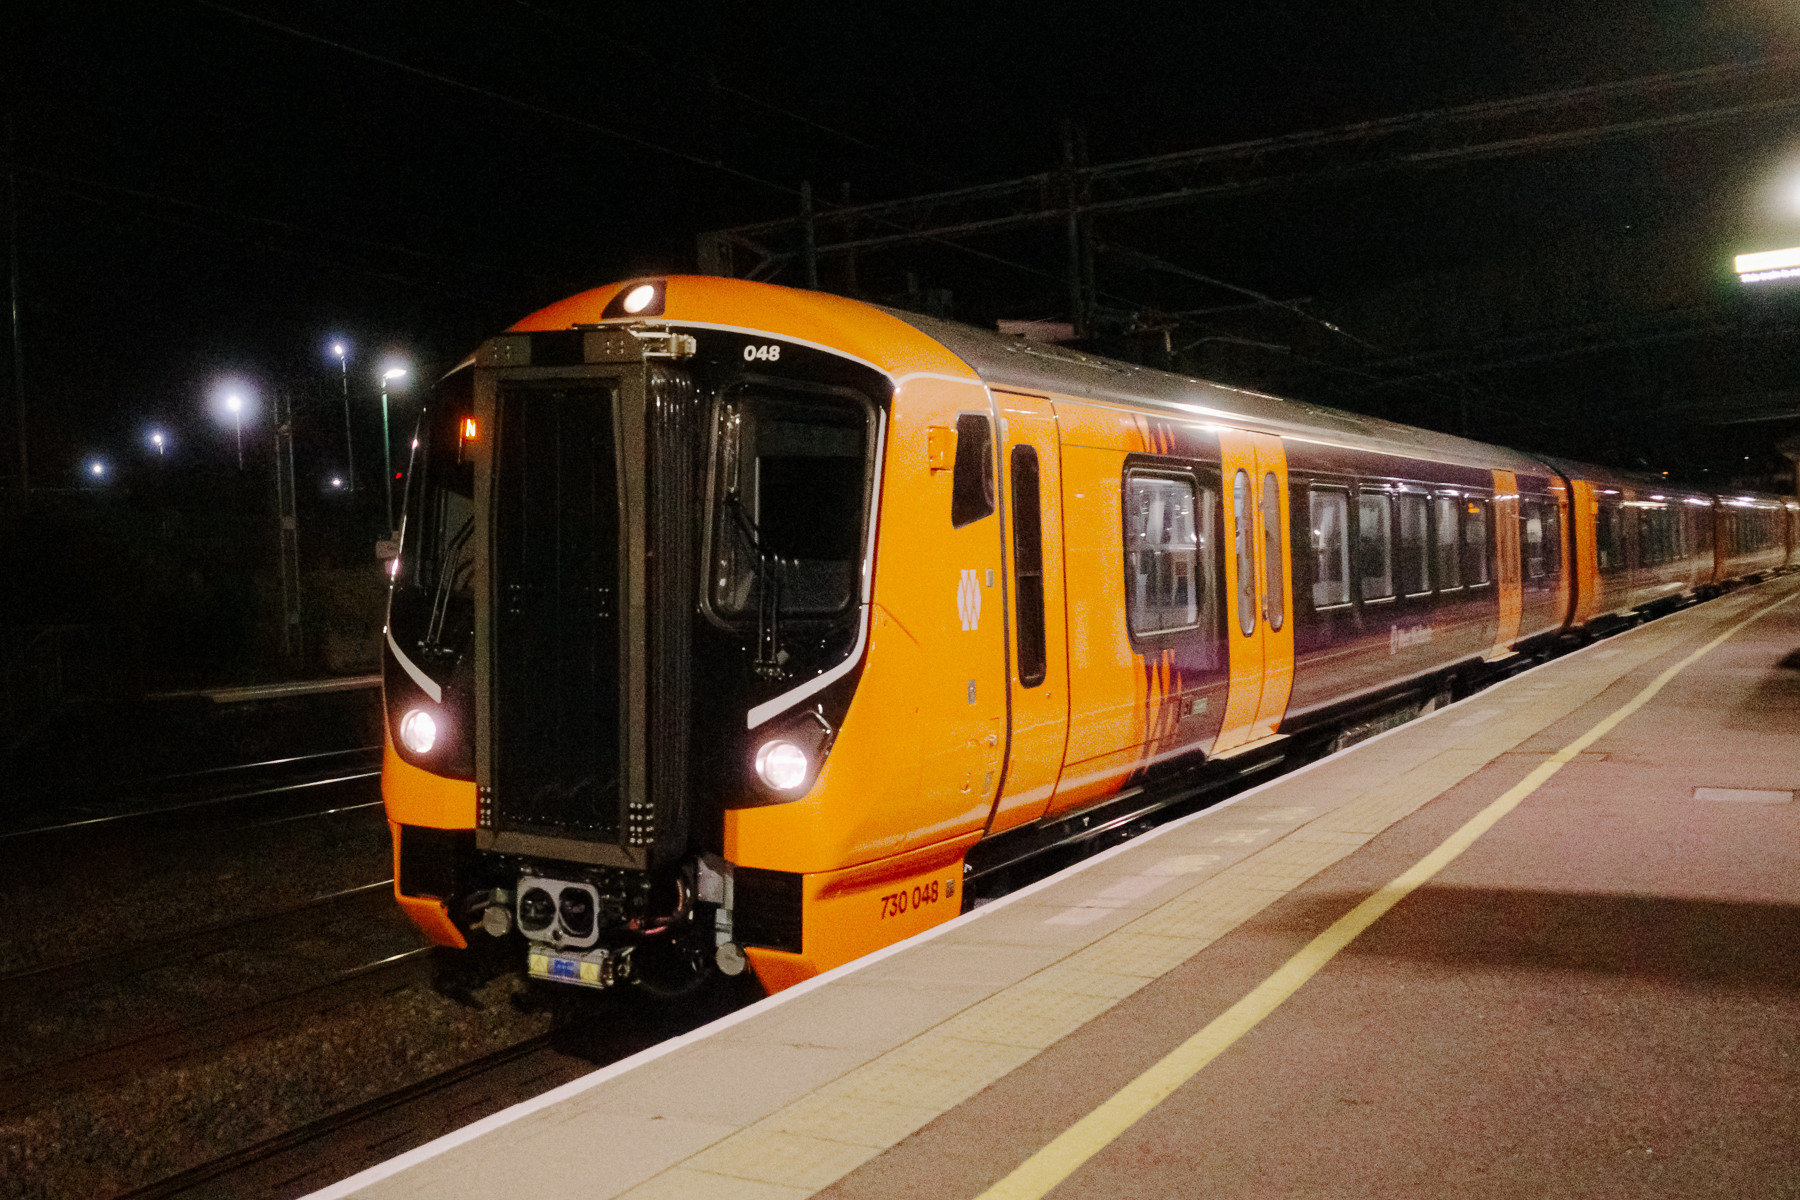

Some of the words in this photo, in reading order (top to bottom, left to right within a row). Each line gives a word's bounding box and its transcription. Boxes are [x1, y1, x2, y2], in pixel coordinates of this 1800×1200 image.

[743, 345, 780, 361] 048
[881, 890, 908, 920] 730
[912, 880, 939, 909] 048
